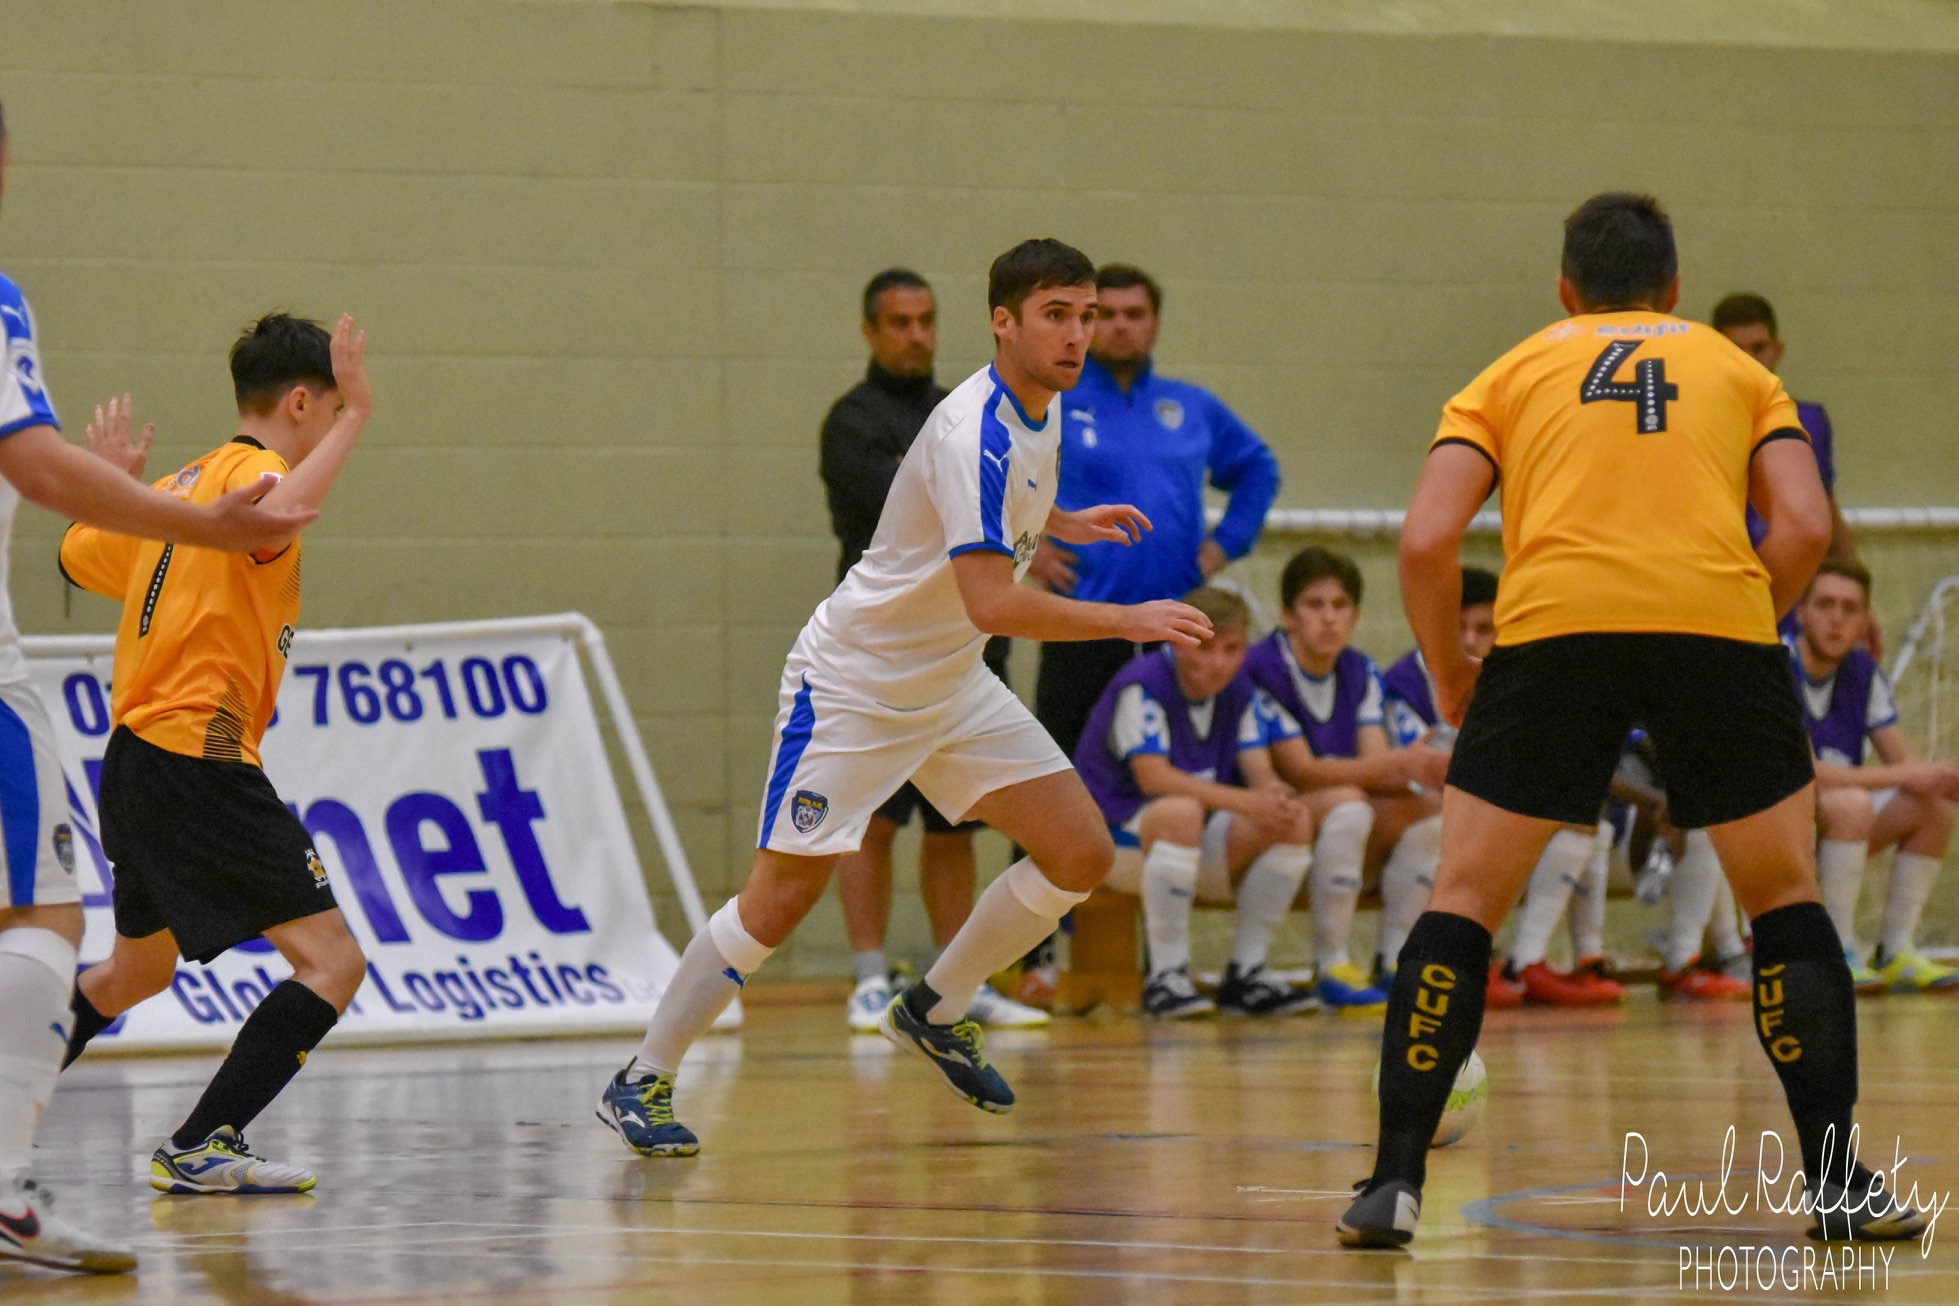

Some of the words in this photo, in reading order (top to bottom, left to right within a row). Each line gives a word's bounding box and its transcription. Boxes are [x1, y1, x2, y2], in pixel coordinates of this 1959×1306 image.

[1581, 340, 1679, 434] 4
[294, 655, 547, 727] 768100
[366, 952, 625, 1020] Logistics
[1407, 964, 1457, 1072] CUFC
